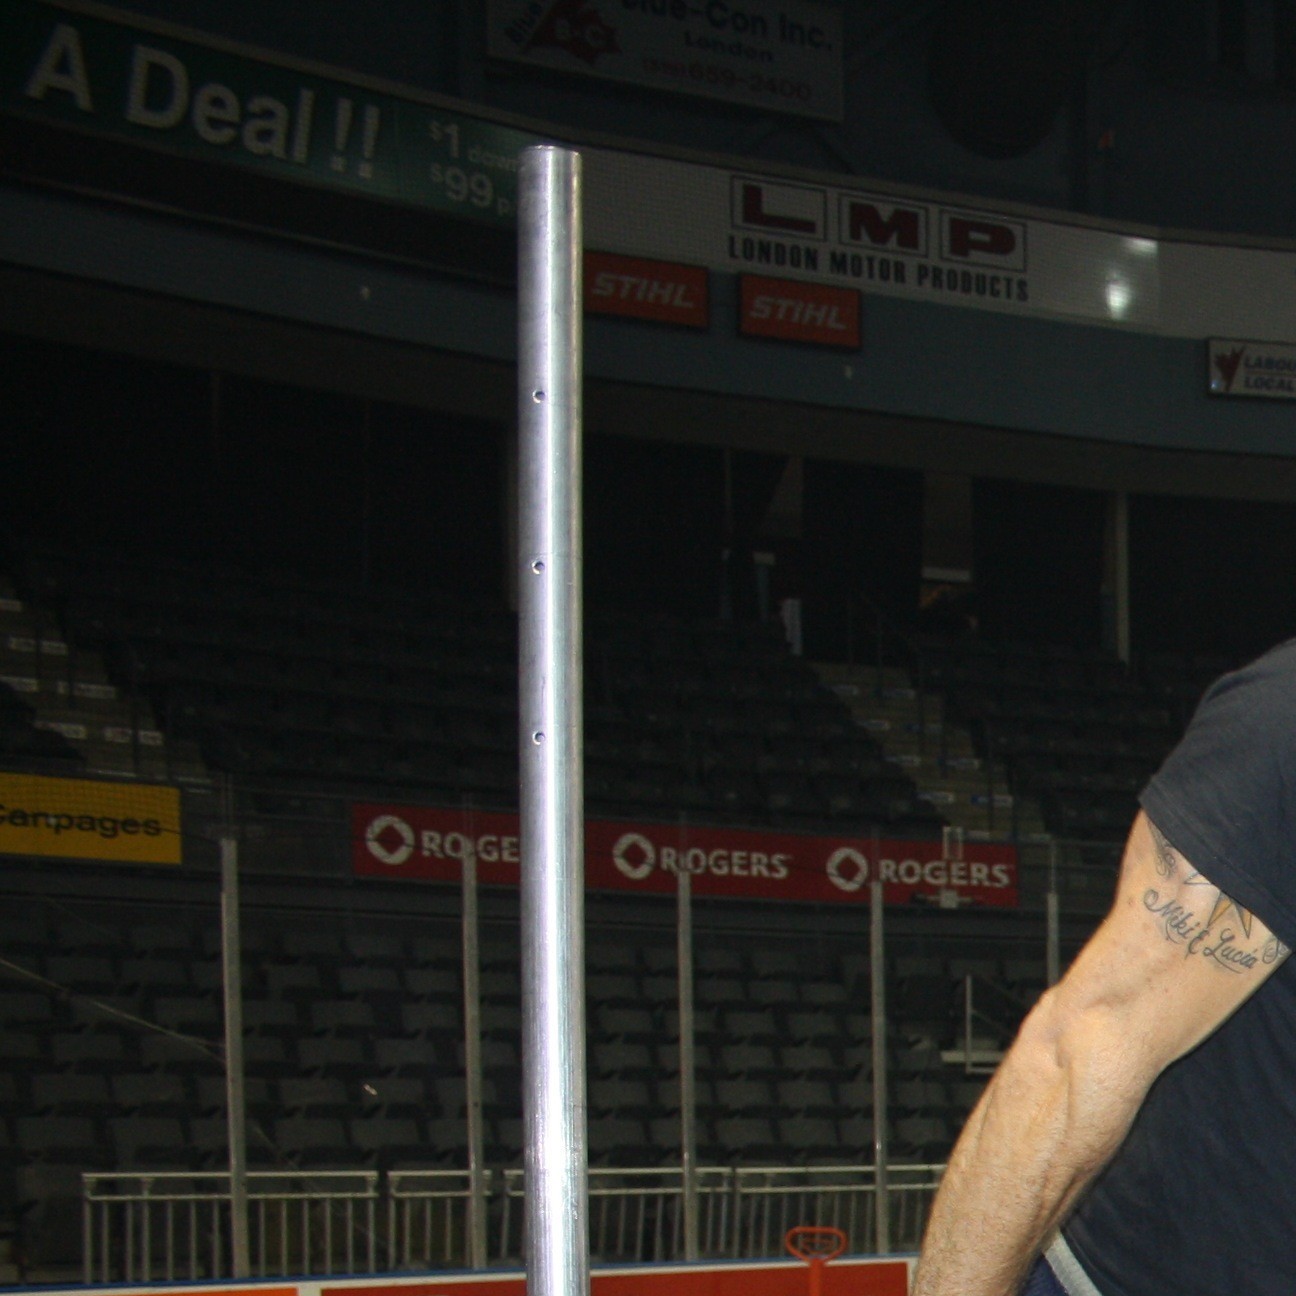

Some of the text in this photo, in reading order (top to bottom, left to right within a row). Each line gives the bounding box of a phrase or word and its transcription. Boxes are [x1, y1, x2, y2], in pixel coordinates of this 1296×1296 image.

[24, 22, 94, 113] A
[125, 44, 314, 165] Deal
[729, 235, 1028, 301] LONDON MOTOR PRODUCTS
[590, 272, 696, 309] STIHL
[749, 295, 849, 331] STIHL
[1244, 376, 1293, 392] LOCAL
[421, 830, 519, 863] ROGE
[660, 846, 790, 879] ROGERS
[877, 858, 1011, 889] ROGERS
